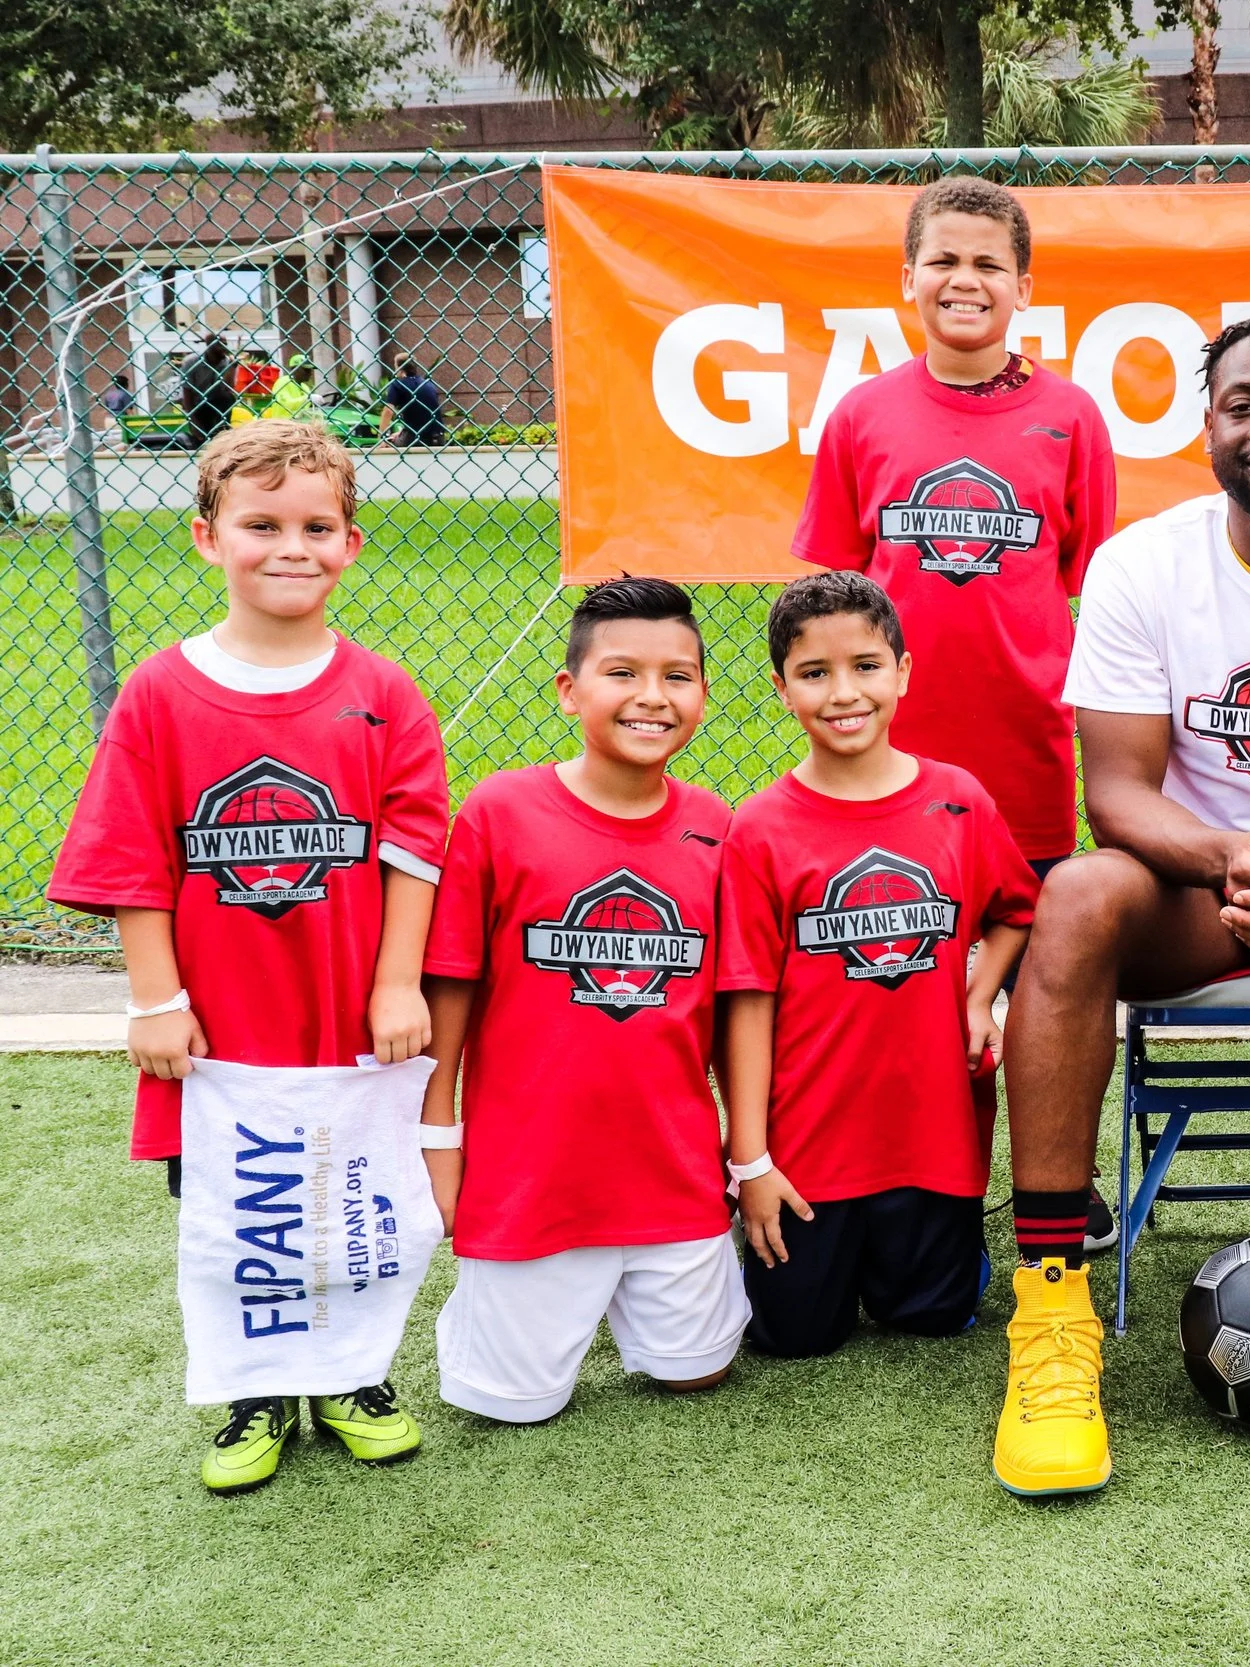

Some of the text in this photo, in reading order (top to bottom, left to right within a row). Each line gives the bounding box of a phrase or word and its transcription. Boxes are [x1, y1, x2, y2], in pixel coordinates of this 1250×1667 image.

[901, 511, 1024, 538] DWYANE WADE
[187, 826, 346, 859] DWYANE WADE
[816, 909, 900, 941] DWYANE
[550, 932, 690, 963] DWYANE WADE
[311, 1126, 331, 1155] Life
[310, 1160, 333, 1221] Healthy
[312, 1239, 328, 1256] to
